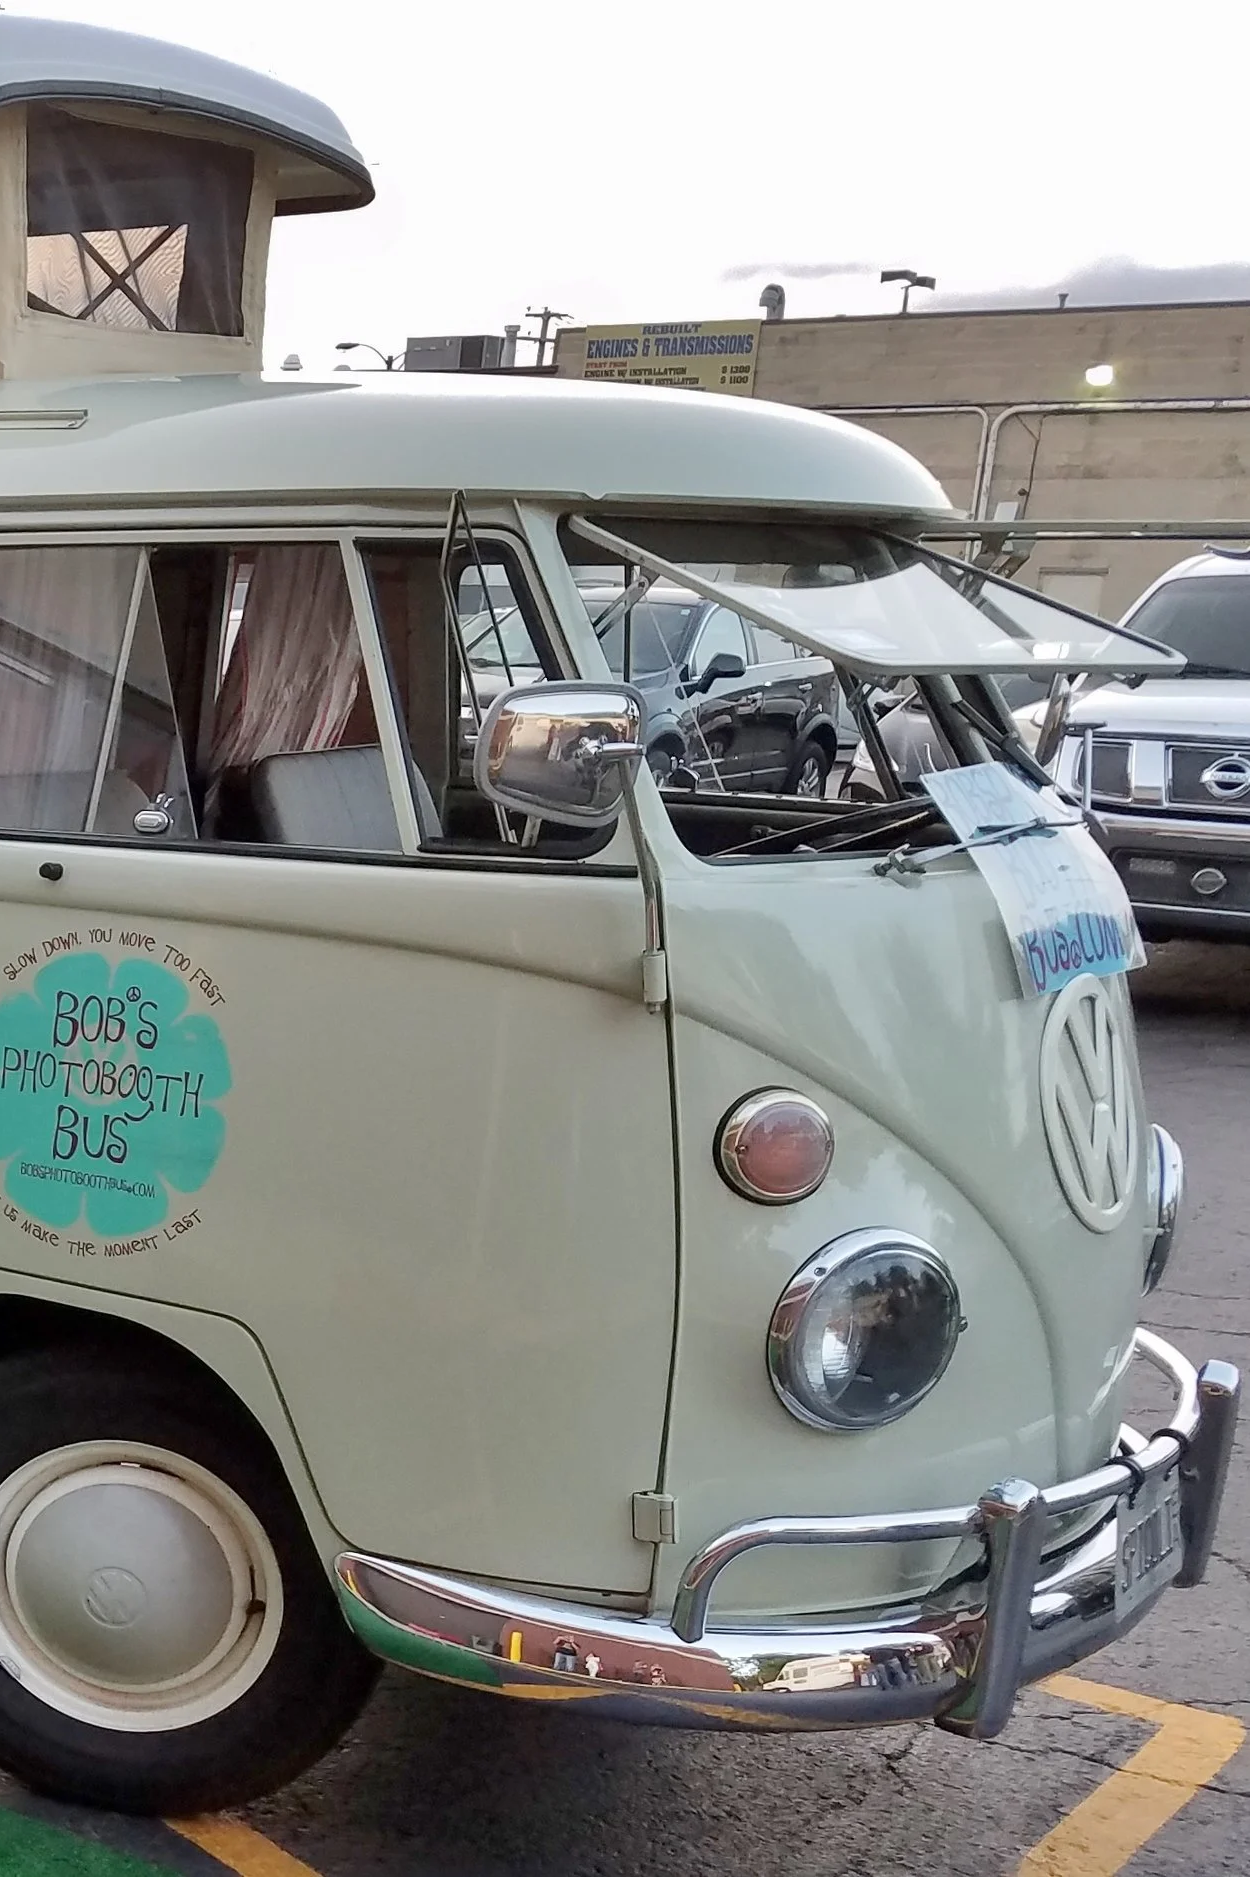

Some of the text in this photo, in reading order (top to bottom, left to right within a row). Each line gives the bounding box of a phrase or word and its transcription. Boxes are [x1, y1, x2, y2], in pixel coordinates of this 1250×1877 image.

[642, 324, 701, 335] REBUILT
[586, 334, 754, 359] ENGINES & TRANSMISSIONS
[629, 367, 687, 376] INSTALLATION
[3, 947, 38, 981] SLOW
[89, 928, 112, 944] YOU
[163, 944, 191, 972] TOO
[1, 1046, 204, 1118] PHOTOBOOTH
[53, 1104, 128, 1163] BUS
[3, 1204, 19, 1222] US
